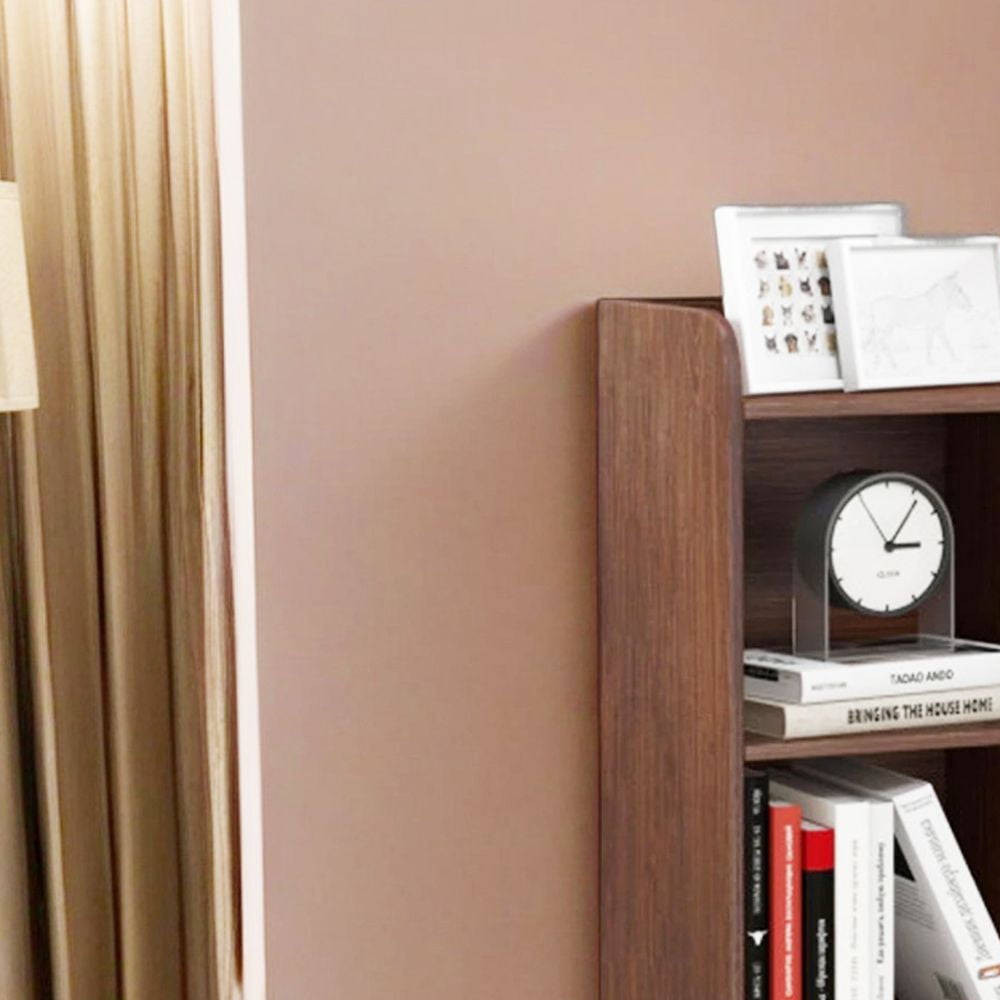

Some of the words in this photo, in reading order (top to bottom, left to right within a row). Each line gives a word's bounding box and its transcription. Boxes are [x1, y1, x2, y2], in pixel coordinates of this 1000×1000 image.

[890, 672, 924, 684] TADAO
[926, 669, 954, 681] ANDO
[847, 707, 900, 725] BRINGING
[902, 703, 925, 720] THE
[926, 700, 962, 718] HOUSE
[963, 696, 994, 714] HOME
